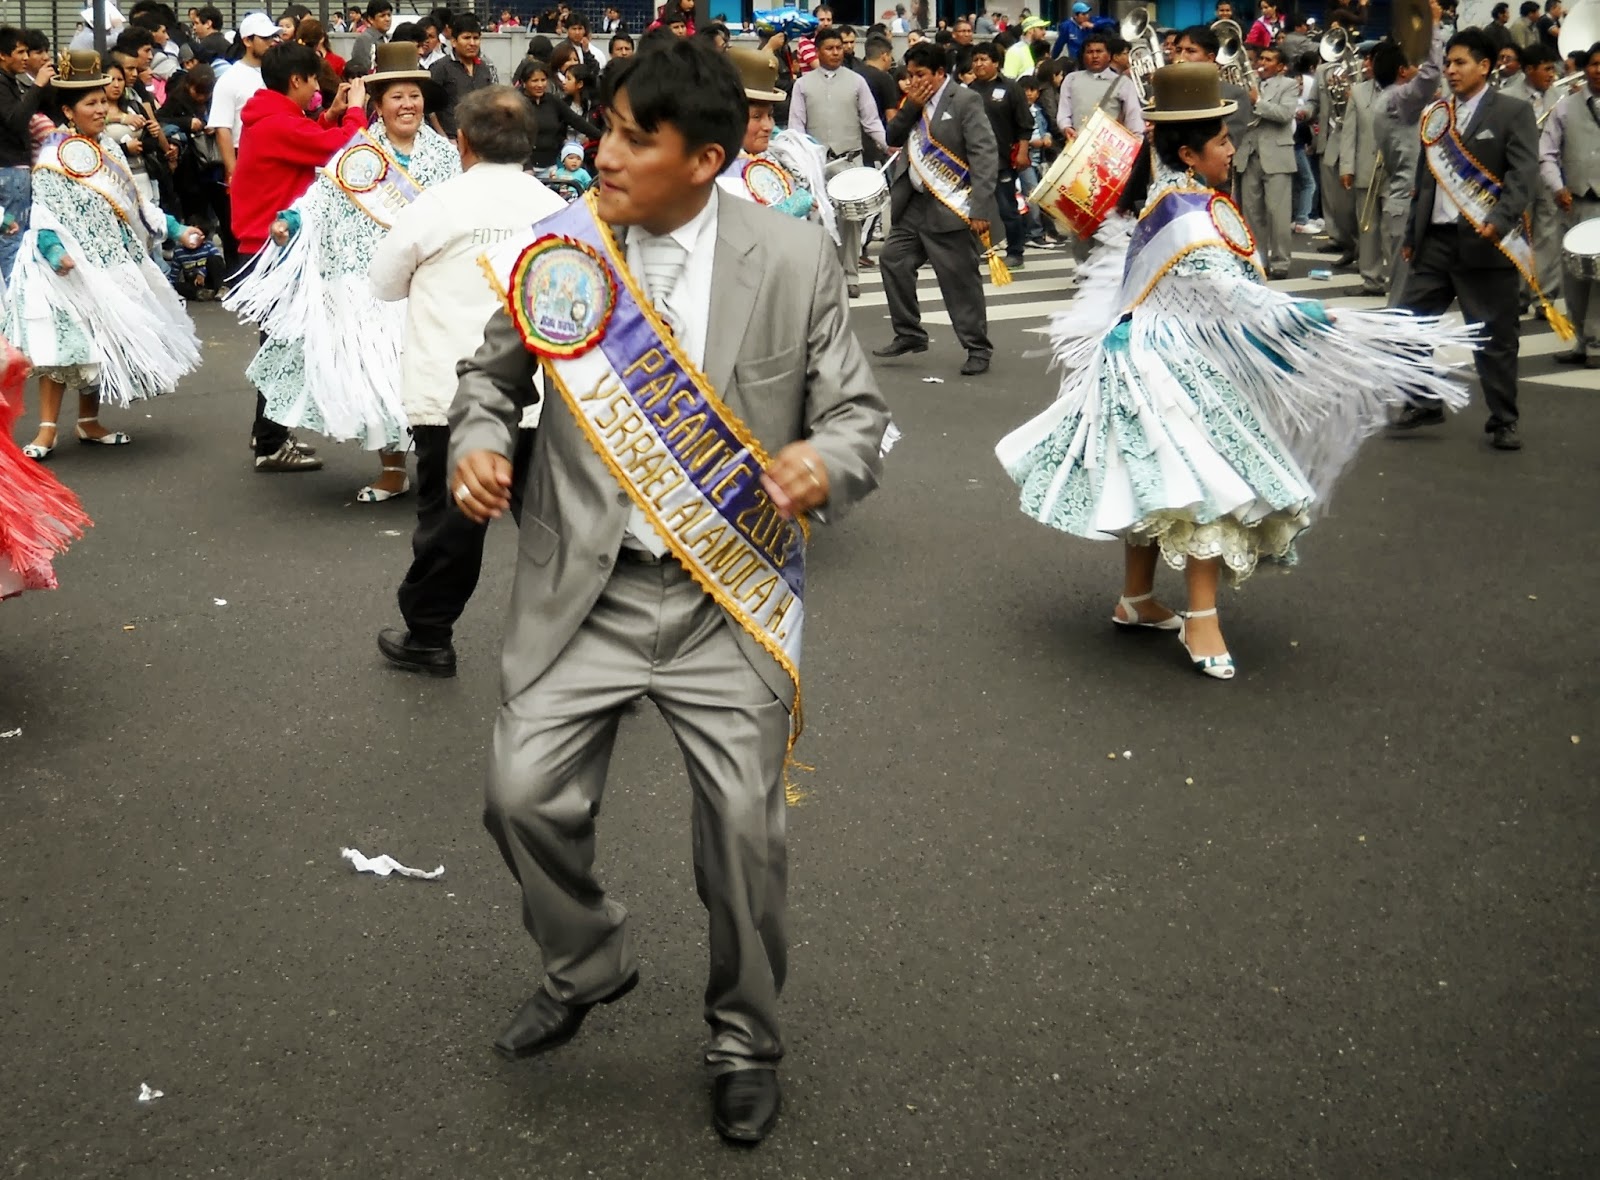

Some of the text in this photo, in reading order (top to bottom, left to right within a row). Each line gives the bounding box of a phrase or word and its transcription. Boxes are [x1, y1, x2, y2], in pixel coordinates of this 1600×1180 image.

[580, 370, 685, 511] YSRRAEL
[622, 347, 795, 568] PASANTE 2013
